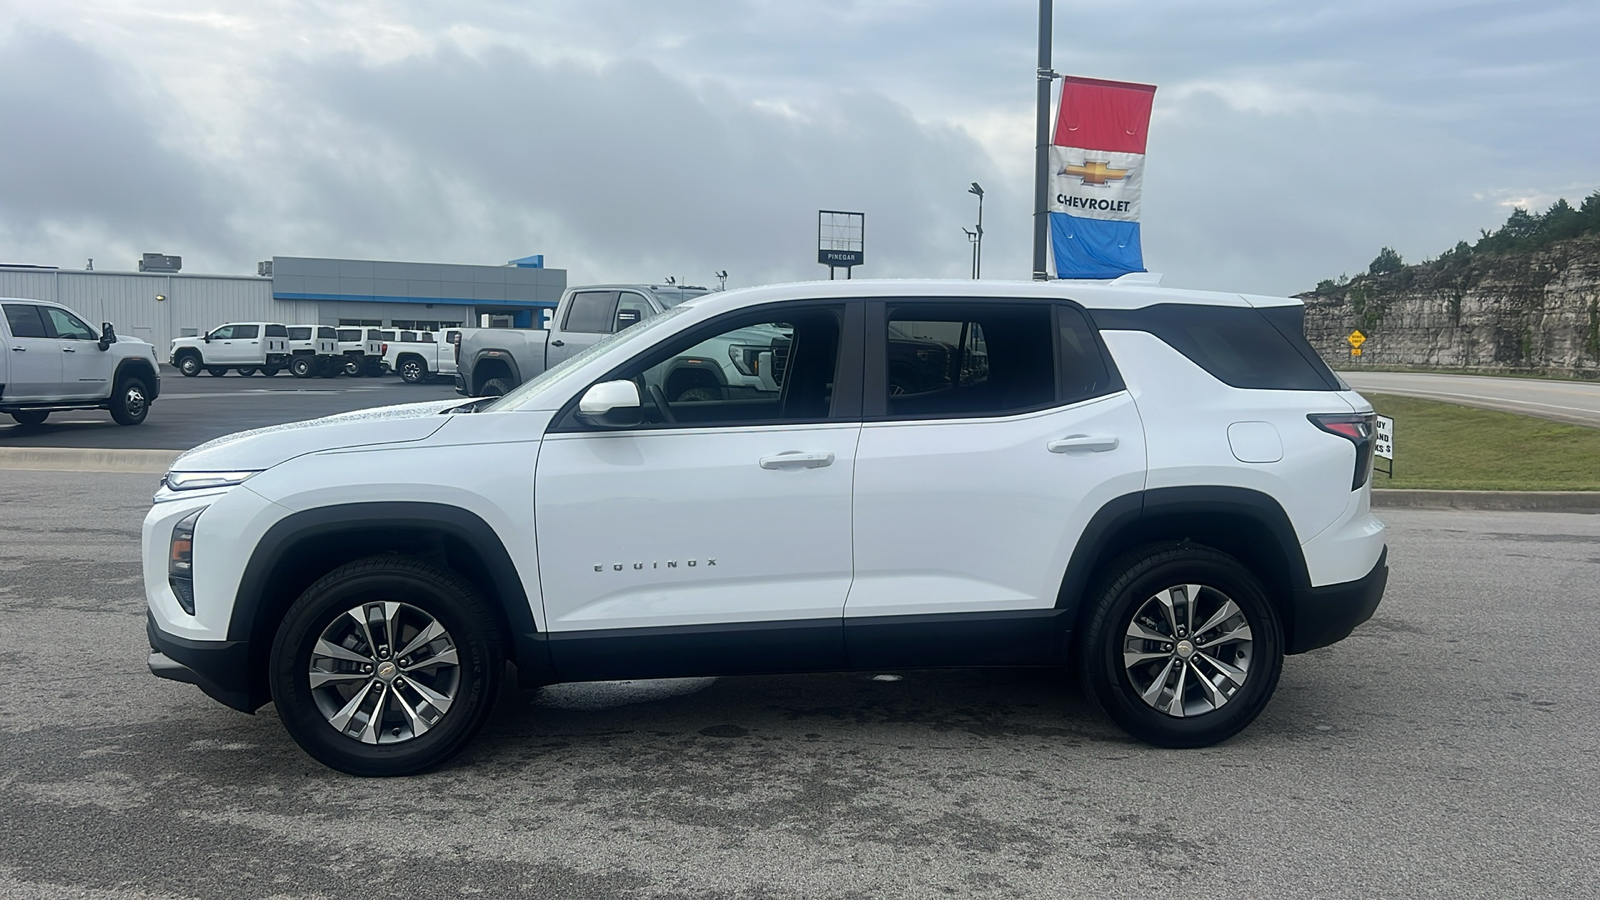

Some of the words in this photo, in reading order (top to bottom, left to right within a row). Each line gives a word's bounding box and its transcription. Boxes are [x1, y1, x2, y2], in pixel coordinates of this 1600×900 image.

[1057, 193, 1130, 212] CHEVROLET
[827, 253, 855, 261] PINEGAR
[1376, 420, 1386, 429] UY
[593, 558, 717, 572] EQUINOX
